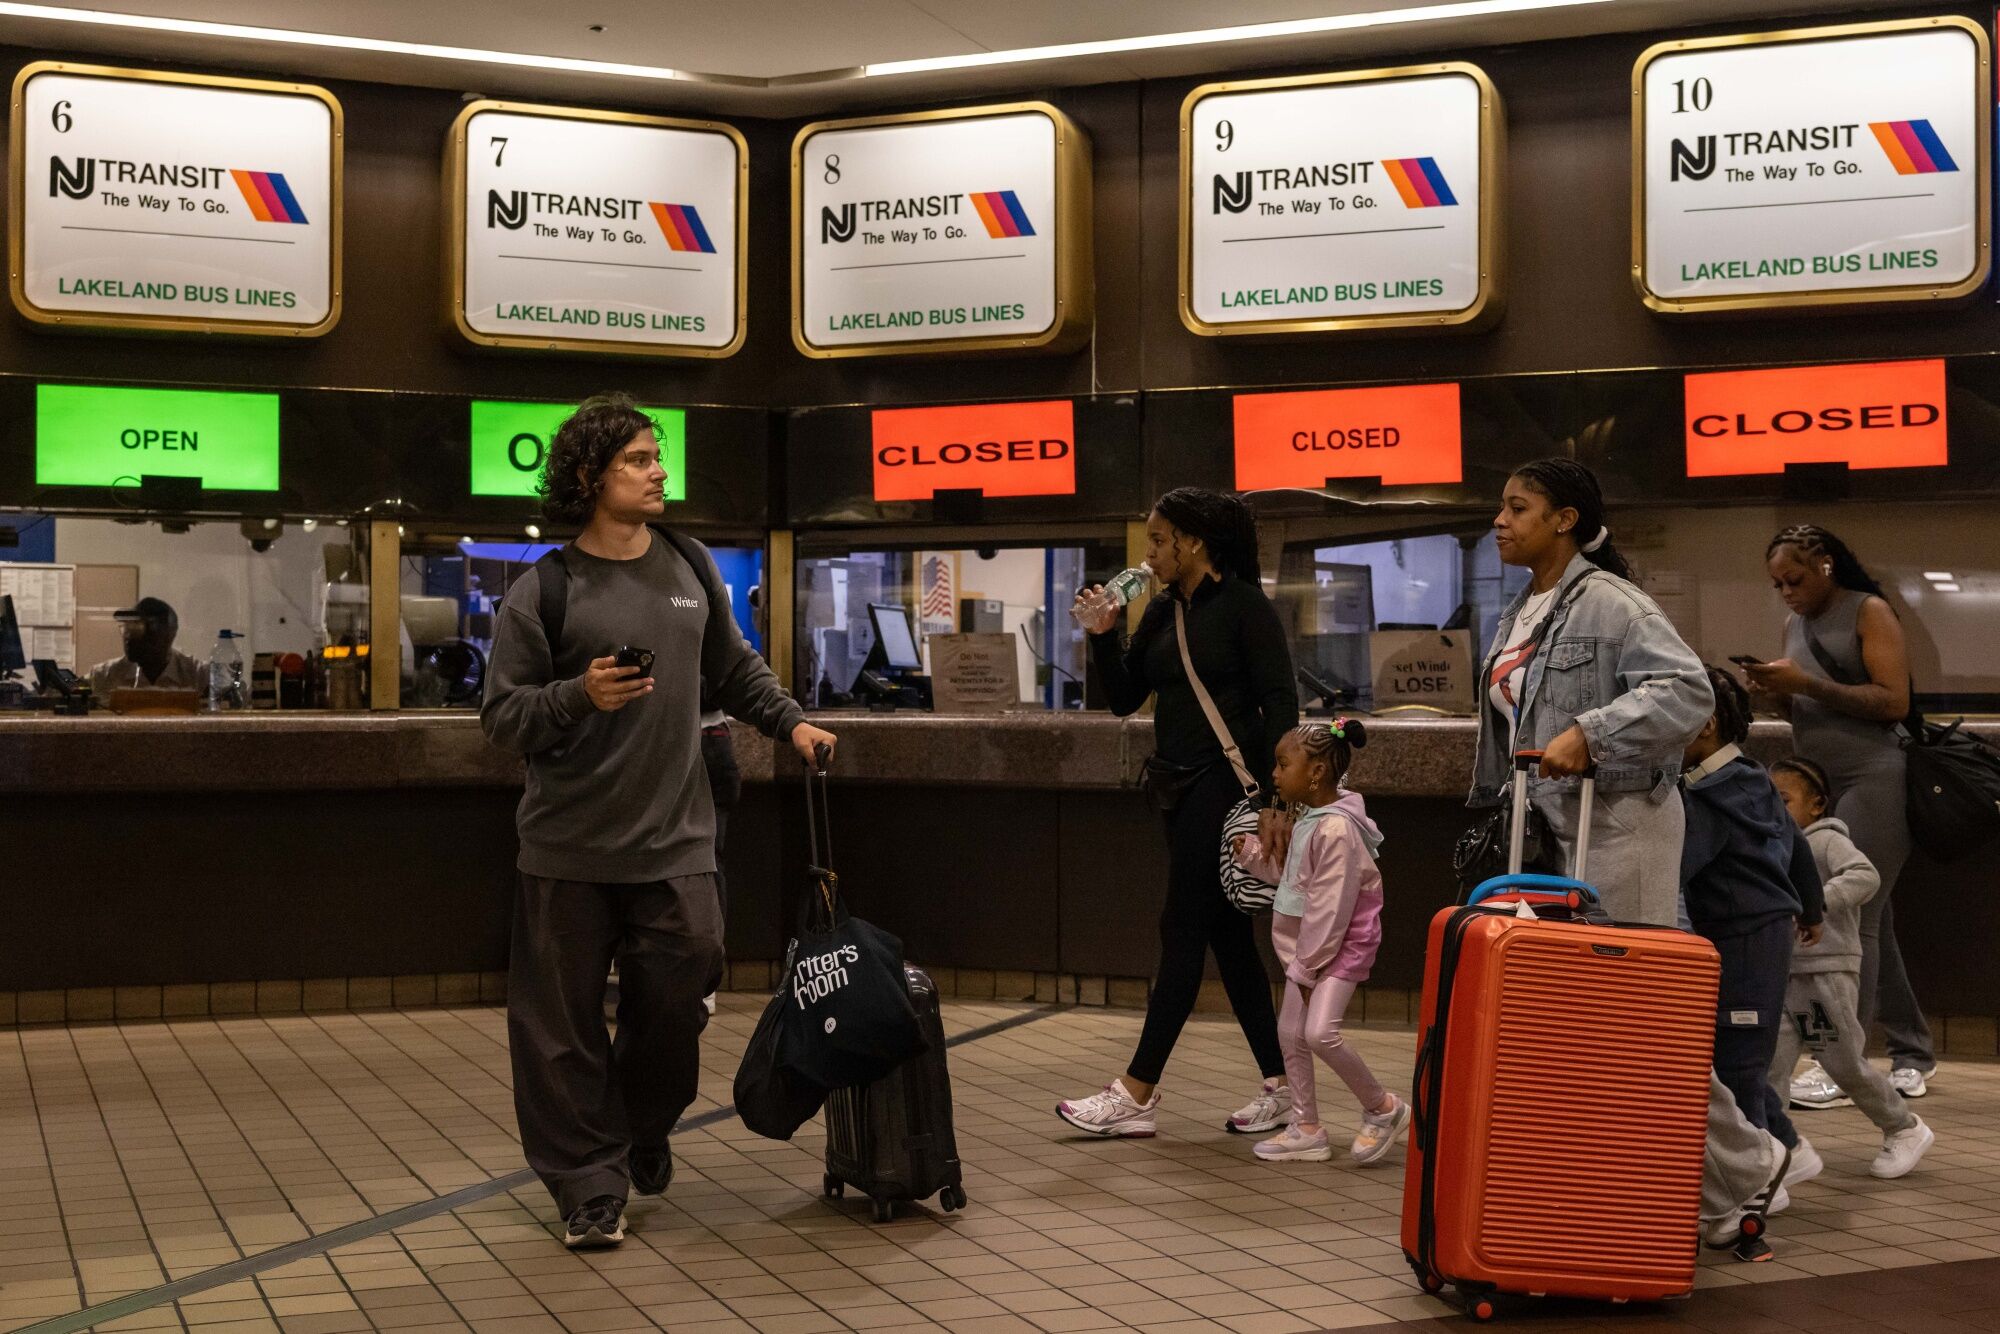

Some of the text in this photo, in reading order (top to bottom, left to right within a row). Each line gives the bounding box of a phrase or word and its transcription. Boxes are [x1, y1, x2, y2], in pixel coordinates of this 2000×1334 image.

[1672, 77, 1713, 114] 10
[52, 100, 72, 133] 6
[1215, 120, 1234, 152] 9
[490, 137, 509, 168] 7
[1671, 124, 1860, 182] NJ TRANSIT
[49, 155, 226, 200] NJ TRANSIT
[824, 154, 841, 185] 8
[1725, 160, 1863, 183] The Way To Go.
[101, 192, 229, 214] The Way To Go.
[1213, 161, 1375, 215] NJ TRANSIT
[488, 189, 643, 230] NJ TRANSIT
[822, 194, 964, 244] NJ TRANSIT
[1258, 195, 1378, 217] The Way To Go.
[533, 224, 647, 244] The Way To Go.
[862, 226, 967, 245] The Way To Go.
[1681, 249, 1939, 282] LAKELAND BUS LINES
[59, 278, 297, 308] LAKELAND BUS LINES
[1221, 279, 1444, 308] LAKELAND BUS LINES
[497, 304, 706, 332] LAKELAND BUS LINES
[829, 304, 1025, 331] LAKELAND BUS LINES
[1692, 404, 1940, 437] CLOSED
[120, 430, 198, 451] OPEN
[508, 433, 555, 472] O
[878, 440, 1070, 467] CLOSED
[1292, 427, 1400, 451] CLOSED
[670, 596, 698, 608] Writer
[1394, 677, 1454, 693] LOSE
[794, 945, 859, 994] riter's
[797, 967, 849, 1010] room
